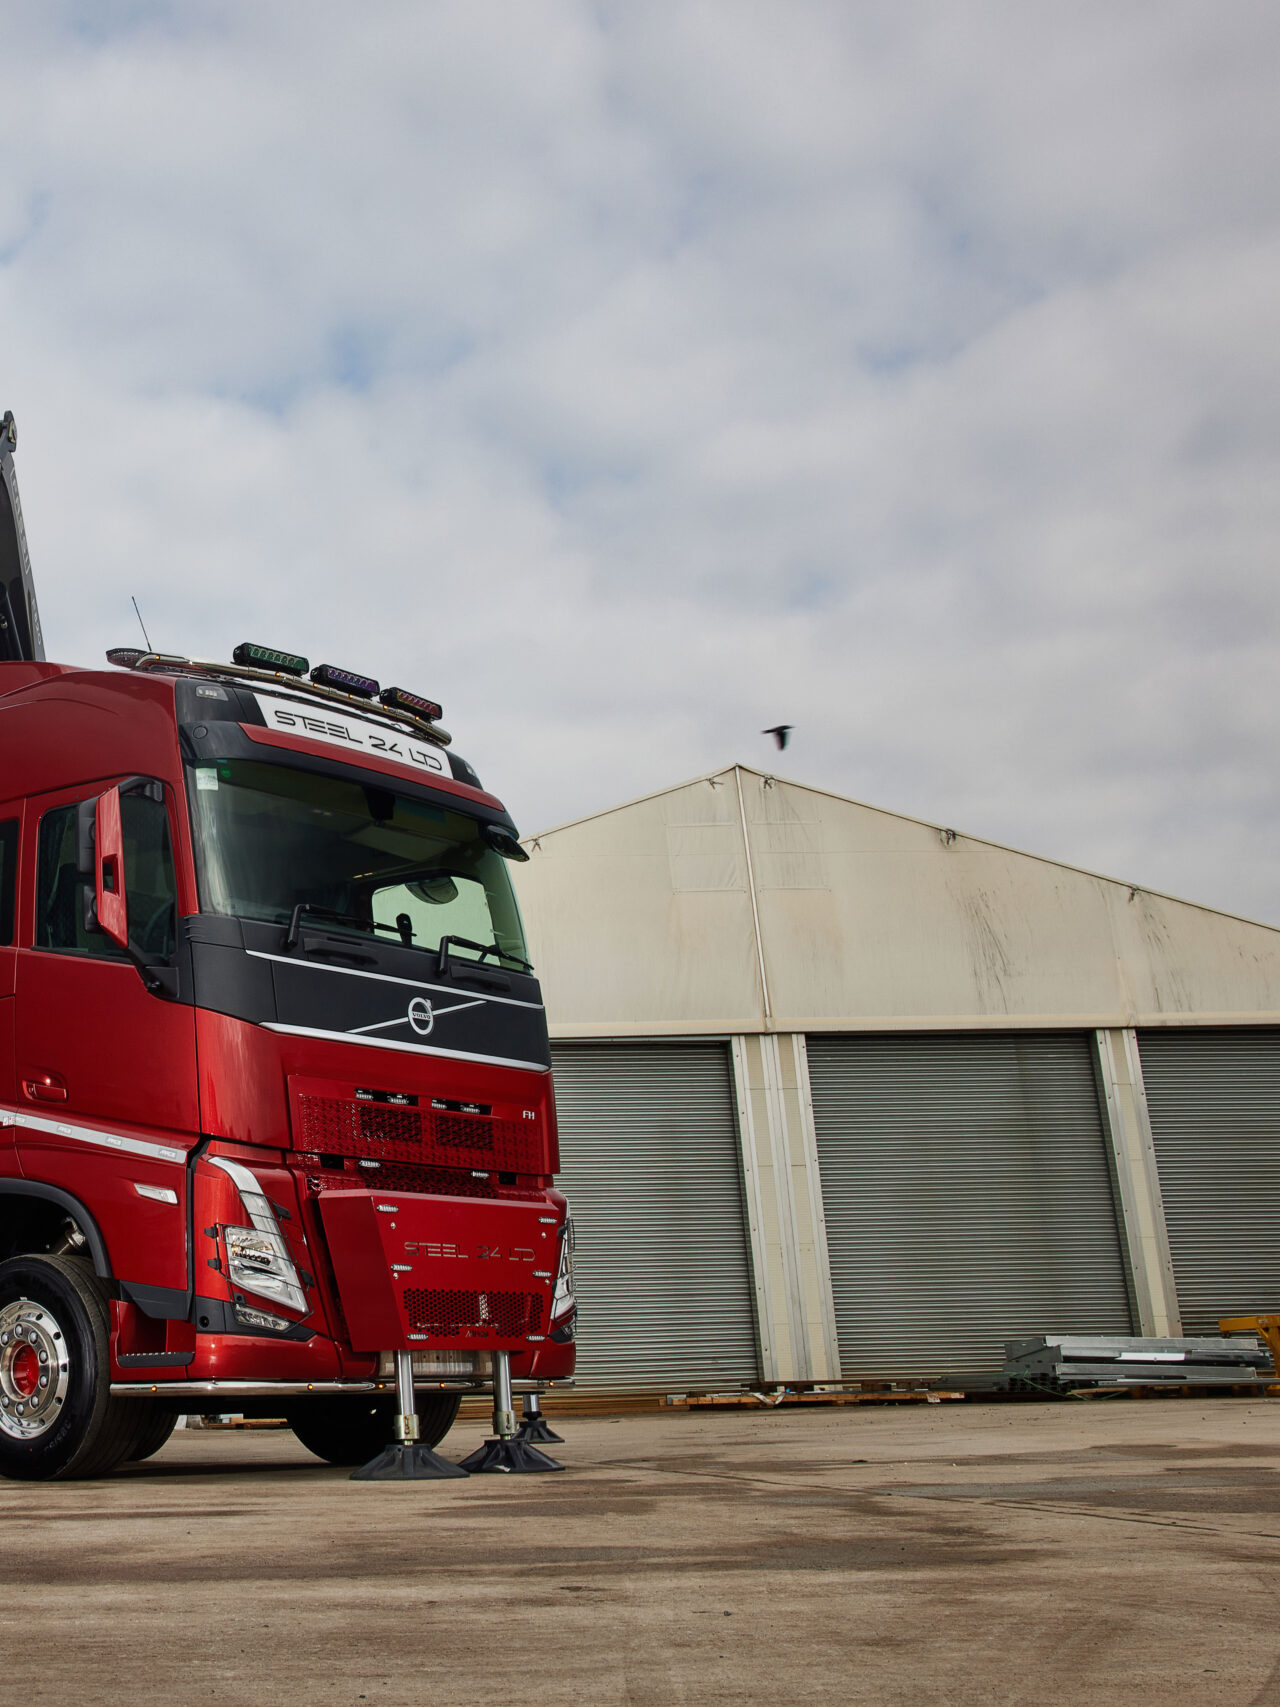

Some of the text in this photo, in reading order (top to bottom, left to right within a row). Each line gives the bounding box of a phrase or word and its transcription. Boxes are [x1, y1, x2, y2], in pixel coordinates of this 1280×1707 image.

[274, 710, 442, 771] STEEL 24 LTD
[412, 1011, 431, 1020] VOLVO
[522, 1110, 535, 1120] FH
[404, 1241, 536, 1261] STEEL 24 LTD
